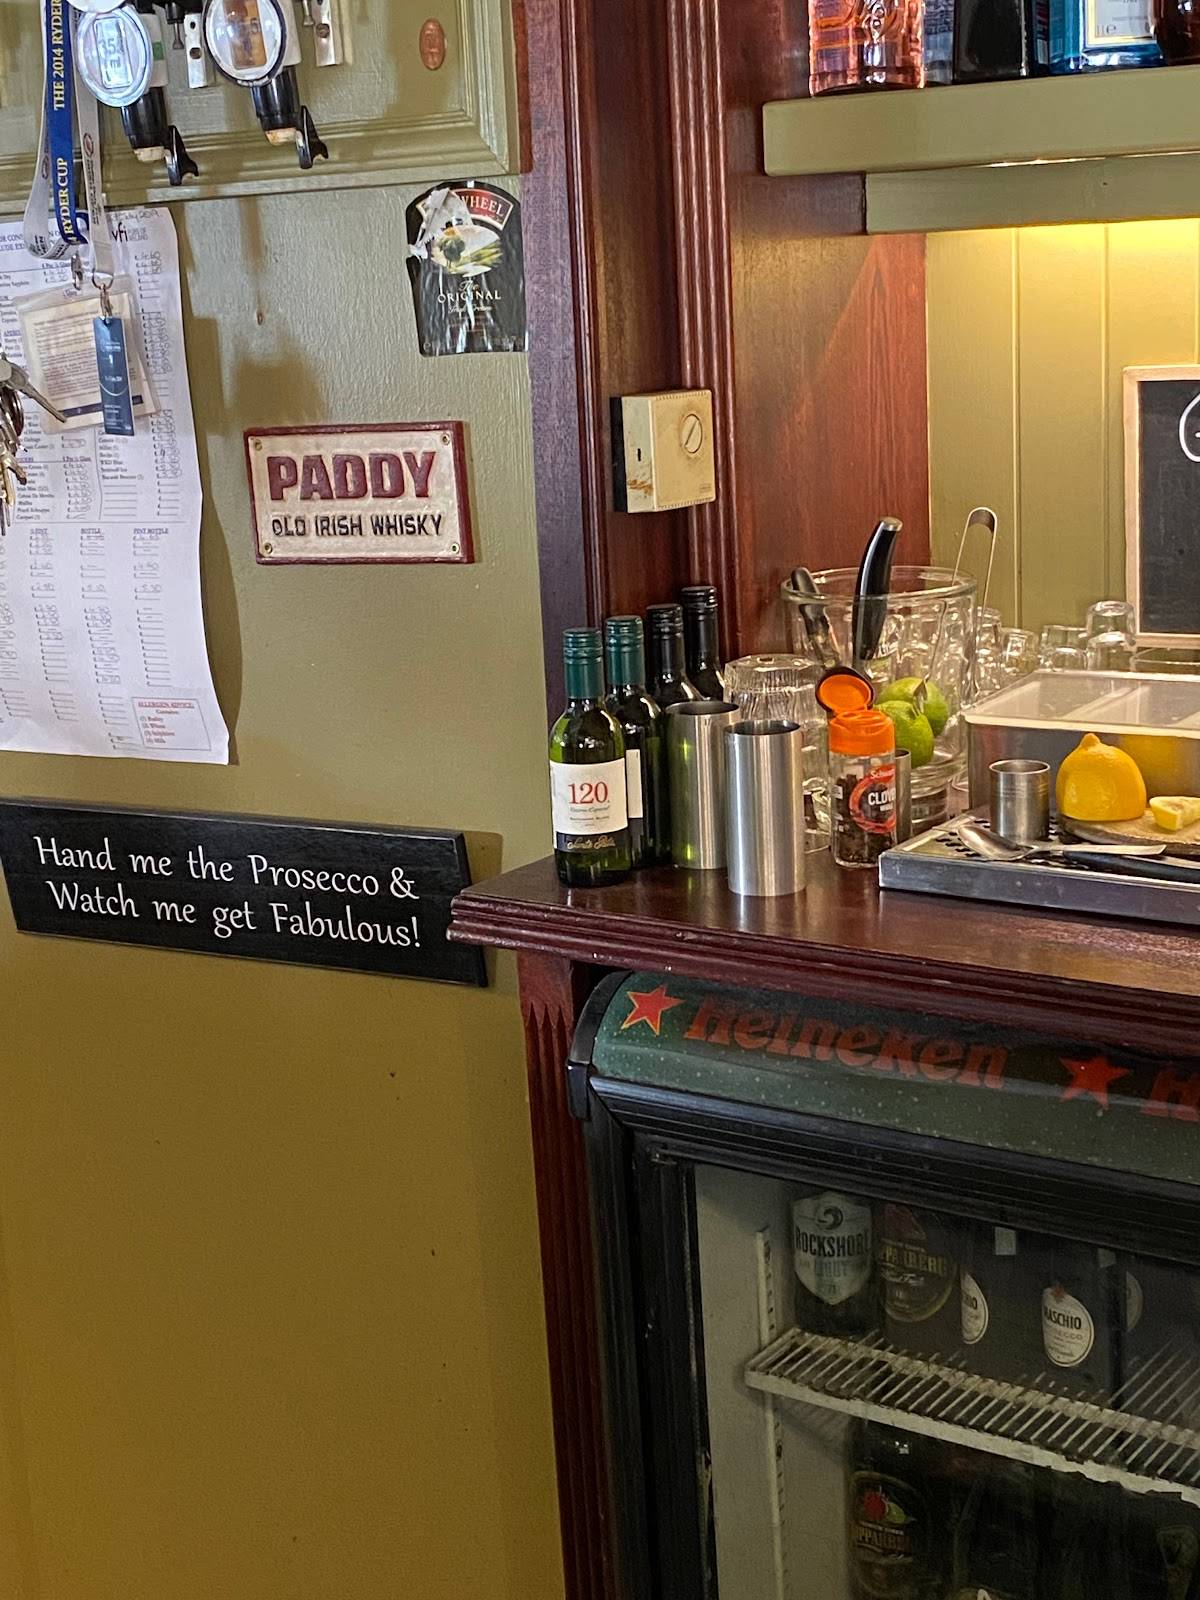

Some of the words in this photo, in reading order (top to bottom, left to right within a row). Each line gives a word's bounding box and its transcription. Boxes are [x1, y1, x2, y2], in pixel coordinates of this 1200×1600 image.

[52, 48, 64, 78] 2014
[53, 81, 65, 111] THE
[57, 157, 68, 187] CUP
[58, 188, 75, 234] RYDER
[267, 451, 437, 501] PADDY
[271, 517, 307, 537] OLD
[315, 514, 363, 536] IRISH
[371, 513, 442, 536] WHISKY
[568, 781, 609, 805] 120
[33, 836, 116, 871] Hand
[129, 854, 173, 876] me
[187, 845, 234, 882] the
[247, 854, 379, 896] Prosecco
[389, 866, 420, 900] &
[46, 880, 140, 918] Watch
[152, 901, 197, 923] me
[212, 901, 257, 939] get
[269, 901, 421, 948] Fabulous!
